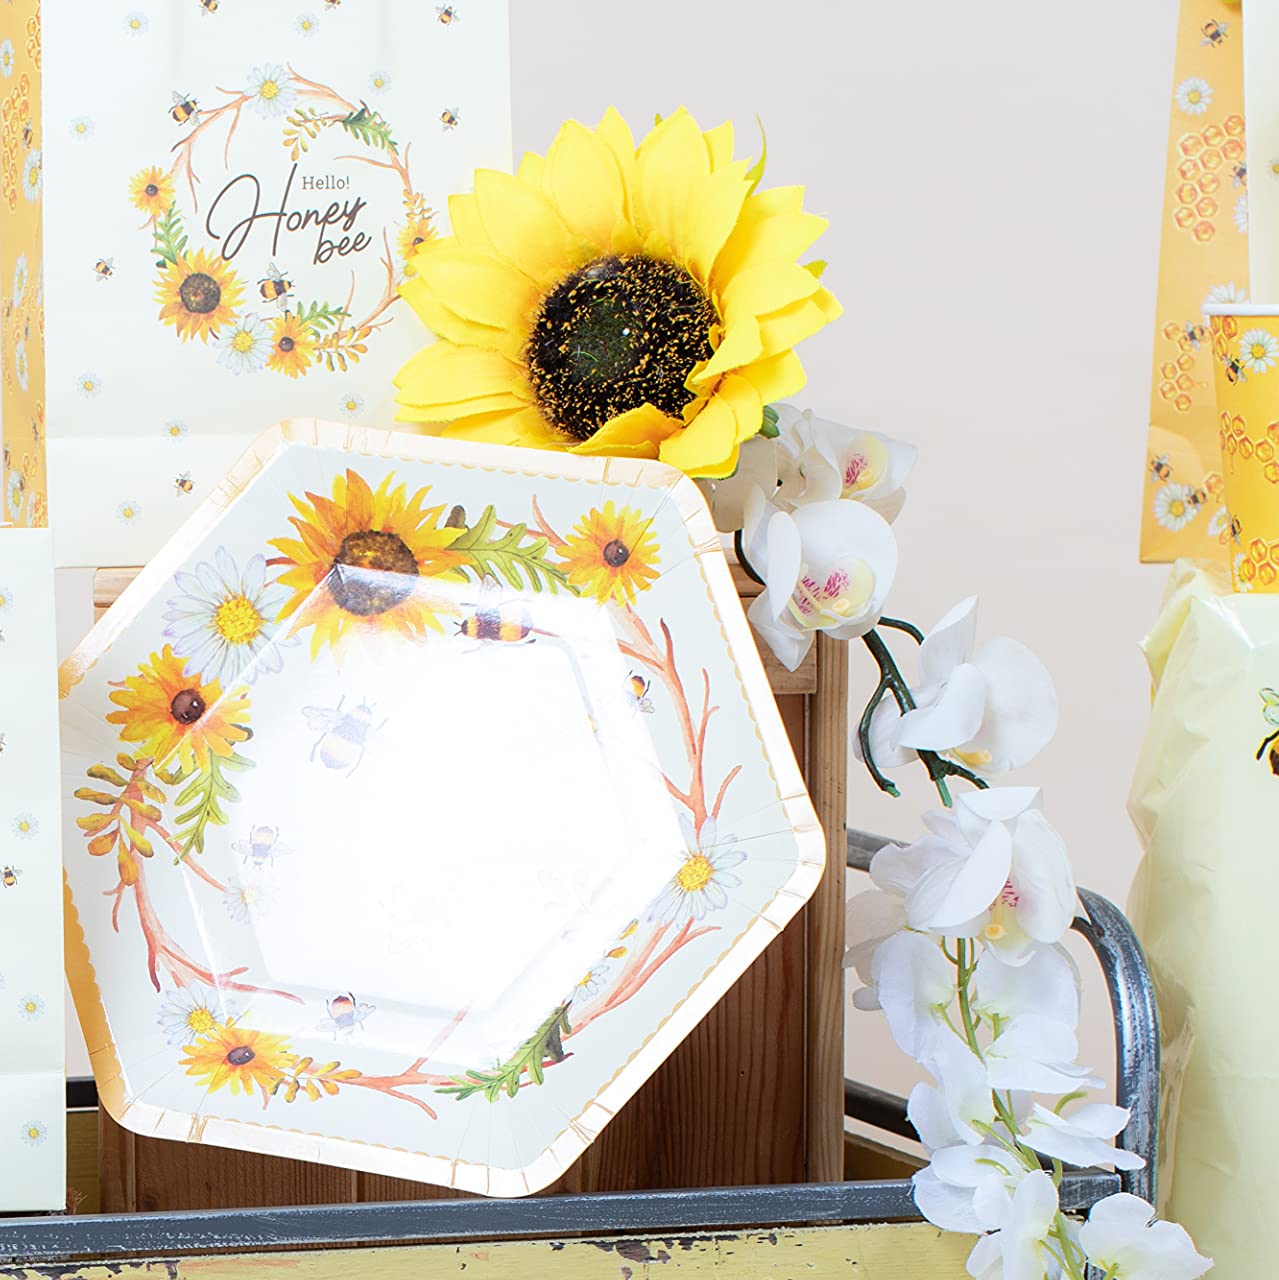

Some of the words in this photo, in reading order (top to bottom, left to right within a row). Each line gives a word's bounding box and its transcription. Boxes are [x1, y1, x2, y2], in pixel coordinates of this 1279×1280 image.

[302, 174, 350, 190] Hello!
[206, 162, 367, 261] Honey
[313, 222, 372, 265] bee
